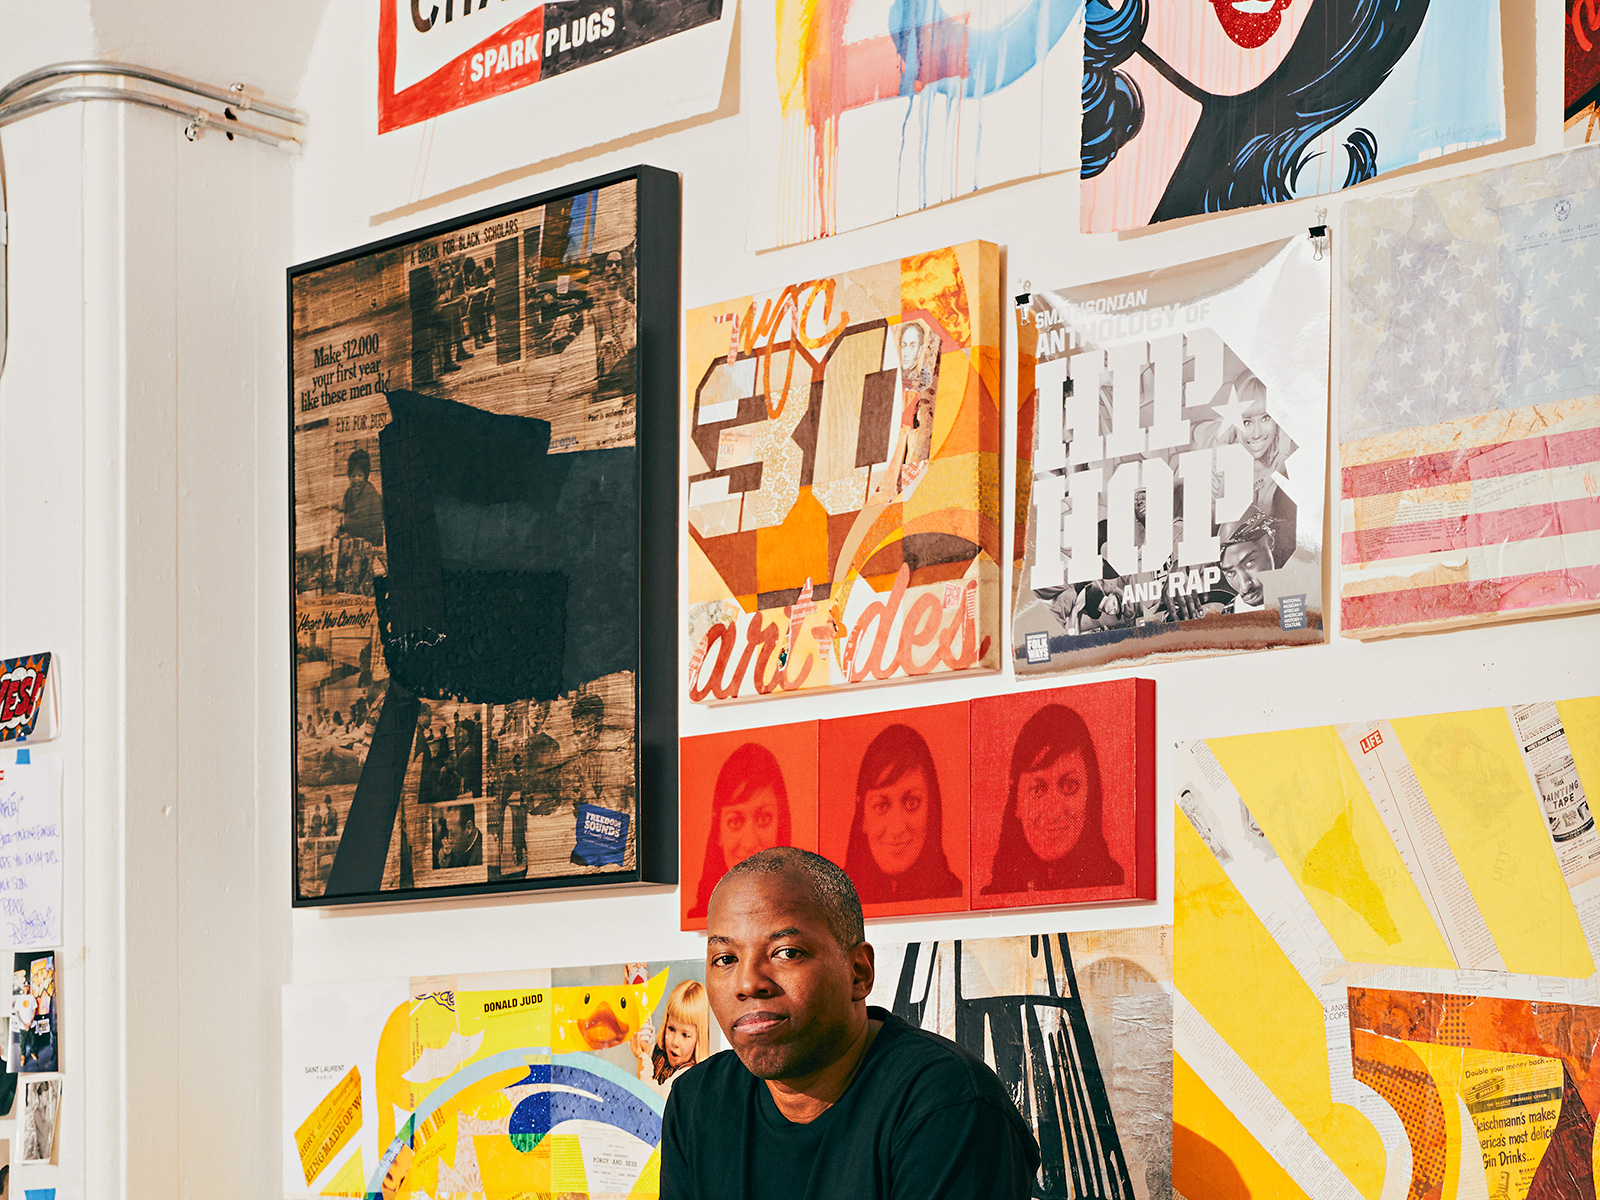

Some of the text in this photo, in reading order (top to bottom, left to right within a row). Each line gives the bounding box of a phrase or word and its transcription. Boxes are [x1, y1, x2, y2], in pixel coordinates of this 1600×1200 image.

[471, 34, 540, 82] SPARK
[545, 7, 615, 57] PLUGS
[418, 244, 439, 264] BREAK
[442, 238, 455, 256] FOR
[459, 231, 480, 251] BLACK
[484, 218, 518, 242] SCHOLARS
[1035, 289, 1148, 330] SMITHSONIAN
[1035, 302, 1211, 358] ANTHOLOGY OF
[314, 344, 341, 368] Make
[312, 360, 380, 394] your first year
[302, 369, 391, 412] like these men did
[1033, 326, 1225, 473] HIP
[353, 414, 367, 430] FOR
[1030, 442, 1254, 590] HOP
[1122, 566, 1221, 605] AND RAP
[322, 612, 338, 629] You
[338, 608, 375, 629] Coming!
[1027, 638, 1048, 650] FOLK
[1028, 648, 1049, 659] WAYS
[1361, 731, 1382, 752] LIFE
[1543, 780, 1579, 802] PAINTING
[1553, 793, 1574, 810] TAPE
[584, 820, 620, 838] SOUNDS
[586, 812, 622, 828] FREEDOM
[484, 998, 518, 1013] DONALD
[520, 994, 543, 1006] JUDD
[1329, 1011, 1348, 1021] COPE
[305, 1066, 318, 1074] SAINT
[1465, 1068, 1488, 1078] Double
[1490, 1066, 1504, 1074] your
[1506, 1062, 1527, 1070] money
[1529, 1108, 1556, 1124] makes
[324, 1125, 344, 1154] MADE
[343, 1108, 354, 1126] OF
[1509, 1130, 1528, 1146] most
[592, 1156, 609, 1164] PORGY
[1483, 1152, 1496, 1170] Gin
